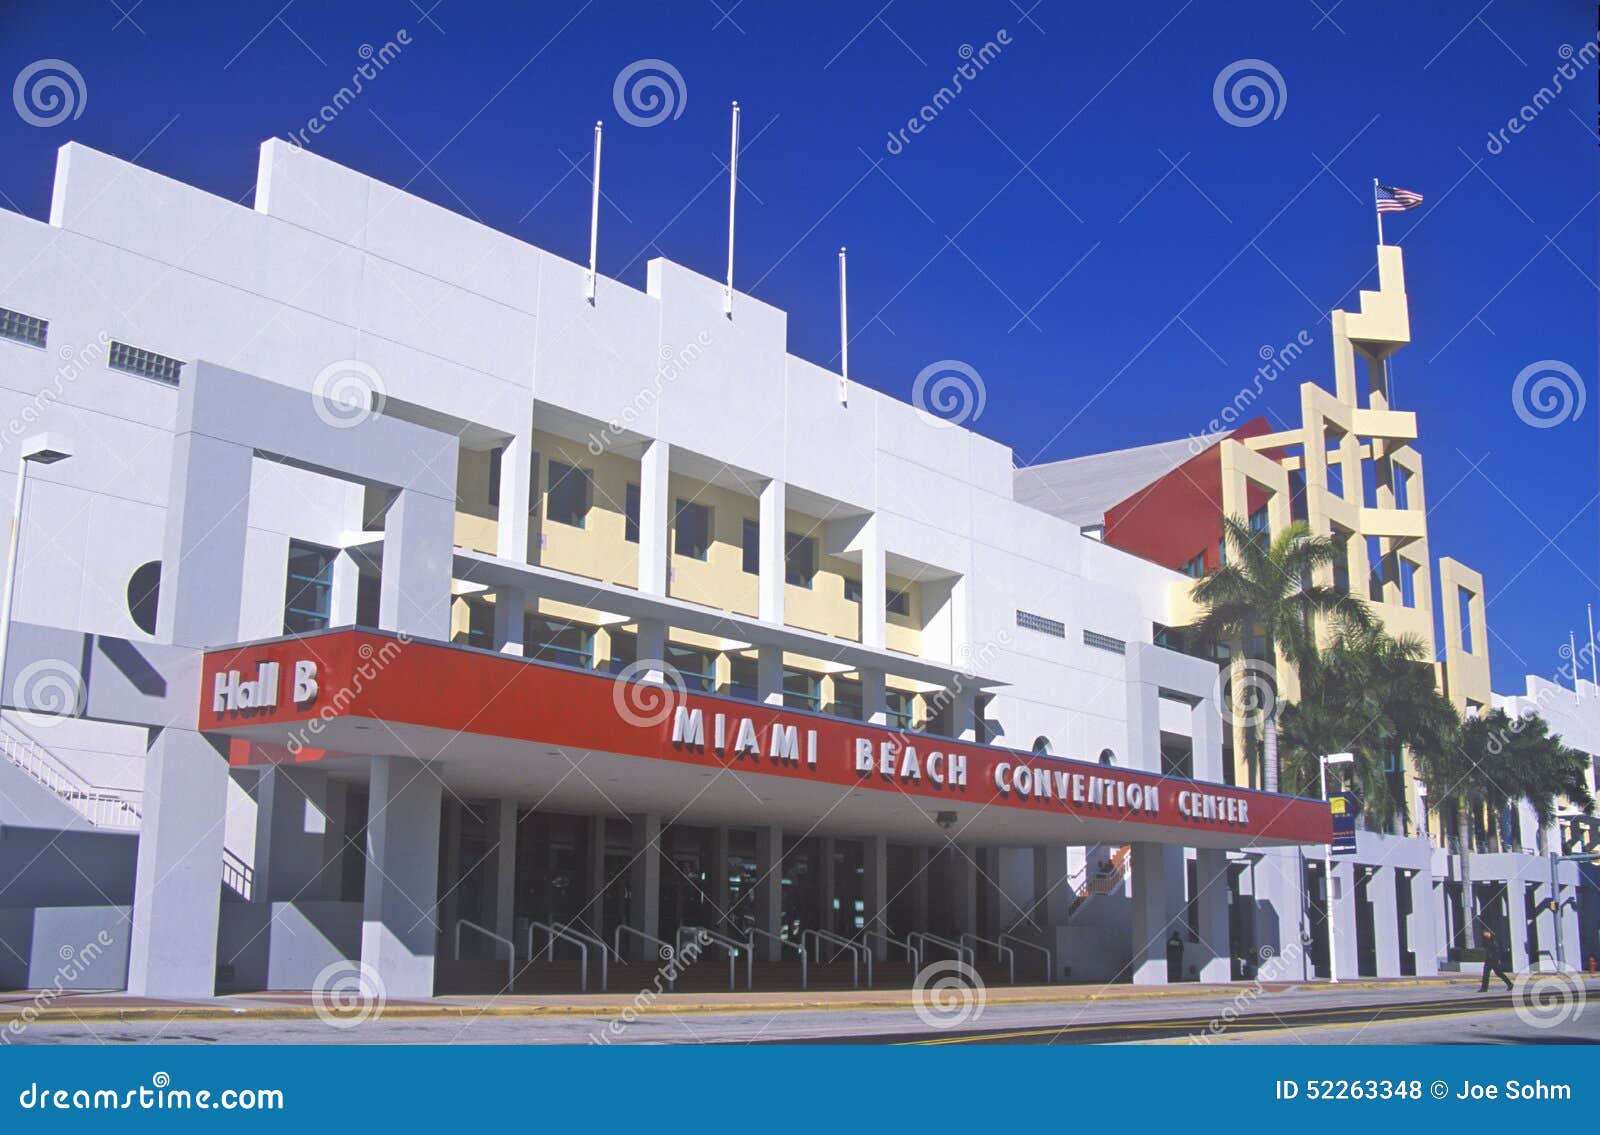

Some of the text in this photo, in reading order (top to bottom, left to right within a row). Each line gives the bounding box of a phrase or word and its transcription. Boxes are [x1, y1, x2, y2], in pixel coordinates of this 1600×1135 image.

[213, 660, 318, 712] Hall B
[671, 706, 1250, 824] MIAMI BEACH CONVENTION CENTER
